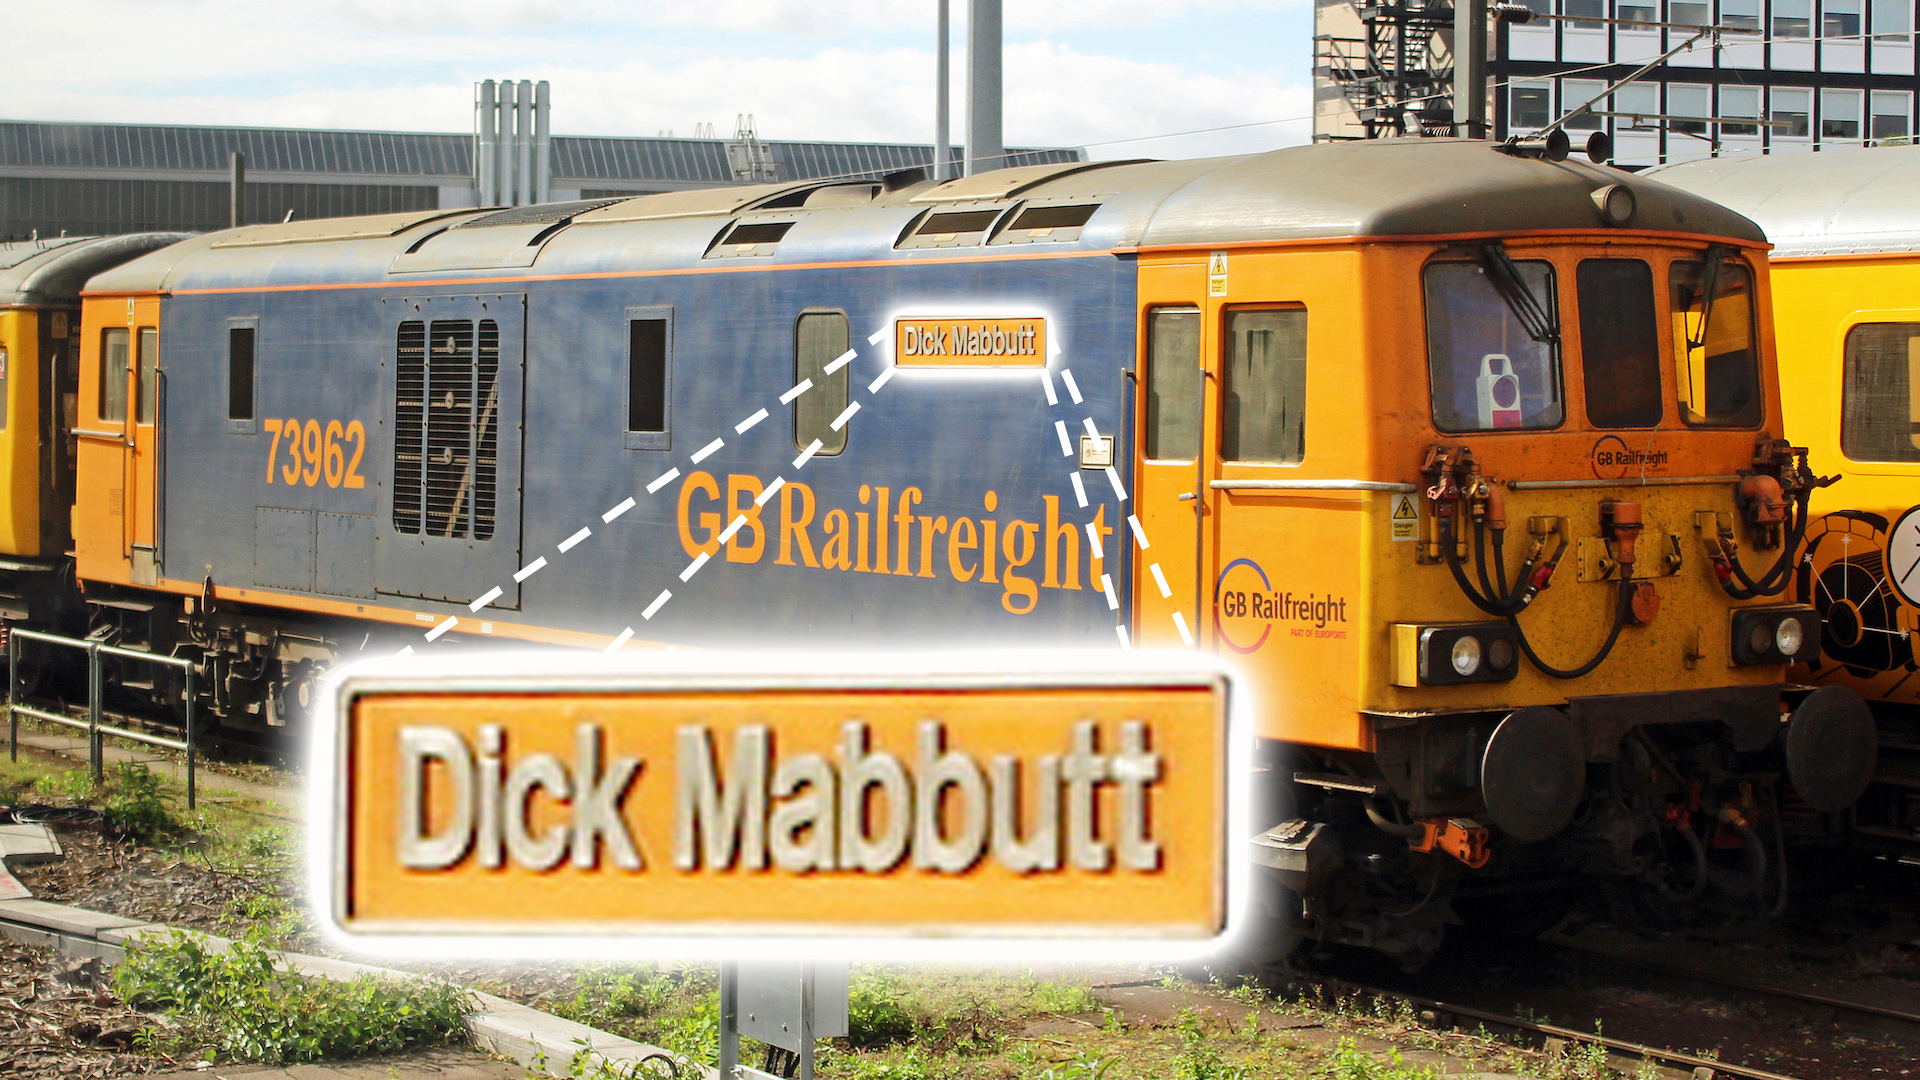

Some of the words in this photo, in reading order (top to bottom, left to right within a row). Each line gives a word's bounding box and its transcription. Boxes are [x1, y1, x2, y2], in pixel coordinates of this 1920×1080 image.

[904, 325, 948, 356] Dick
[951, 324, 1036, 356] Mabbutt
[263, 418, 366, 489] 73962
[1597, 452, 1614, 465] GB
[1616, 448, 1668, 468] Railfreight
[677, 470, 767, 566] GB
[773, 480, 1114, 616] Railfreight
[1223, 590, 1248, 618] GB
[1252, 592, 1347, 629] Railfreight
[1290, 629, 1304, 637] PART
[1306, 629, 1313, 638] OF
[1315, 630, 1347, 640] EUROPORTE
